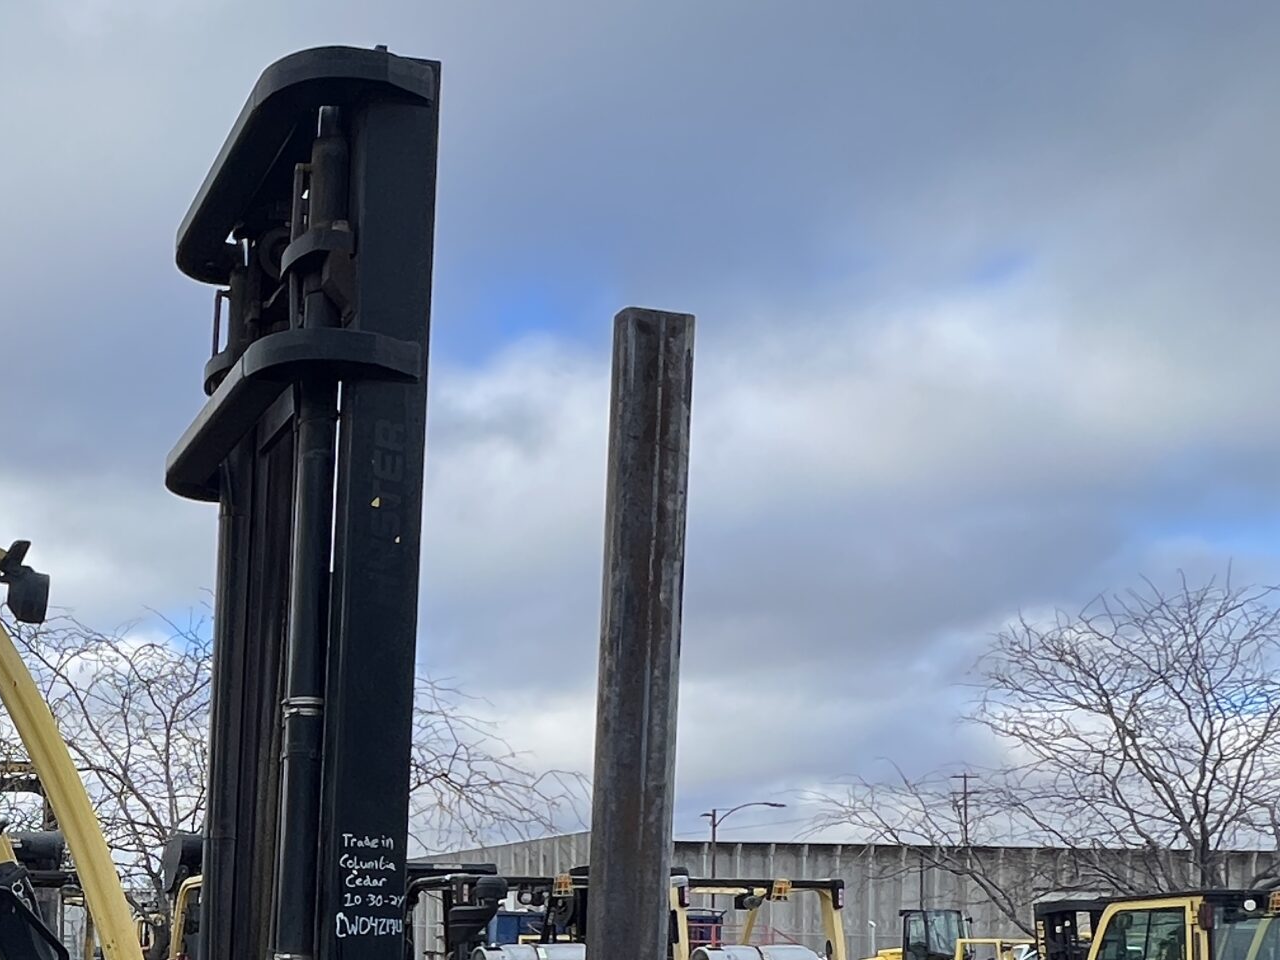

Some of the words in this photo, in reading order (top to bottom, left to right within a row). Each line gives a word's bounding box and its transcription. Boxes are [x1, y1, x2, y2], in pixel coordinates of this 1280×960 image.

[342, 833, 379, 848] Trade
[381, 834, 394, 850] in
[345, 874, 388, 887] Cedar
